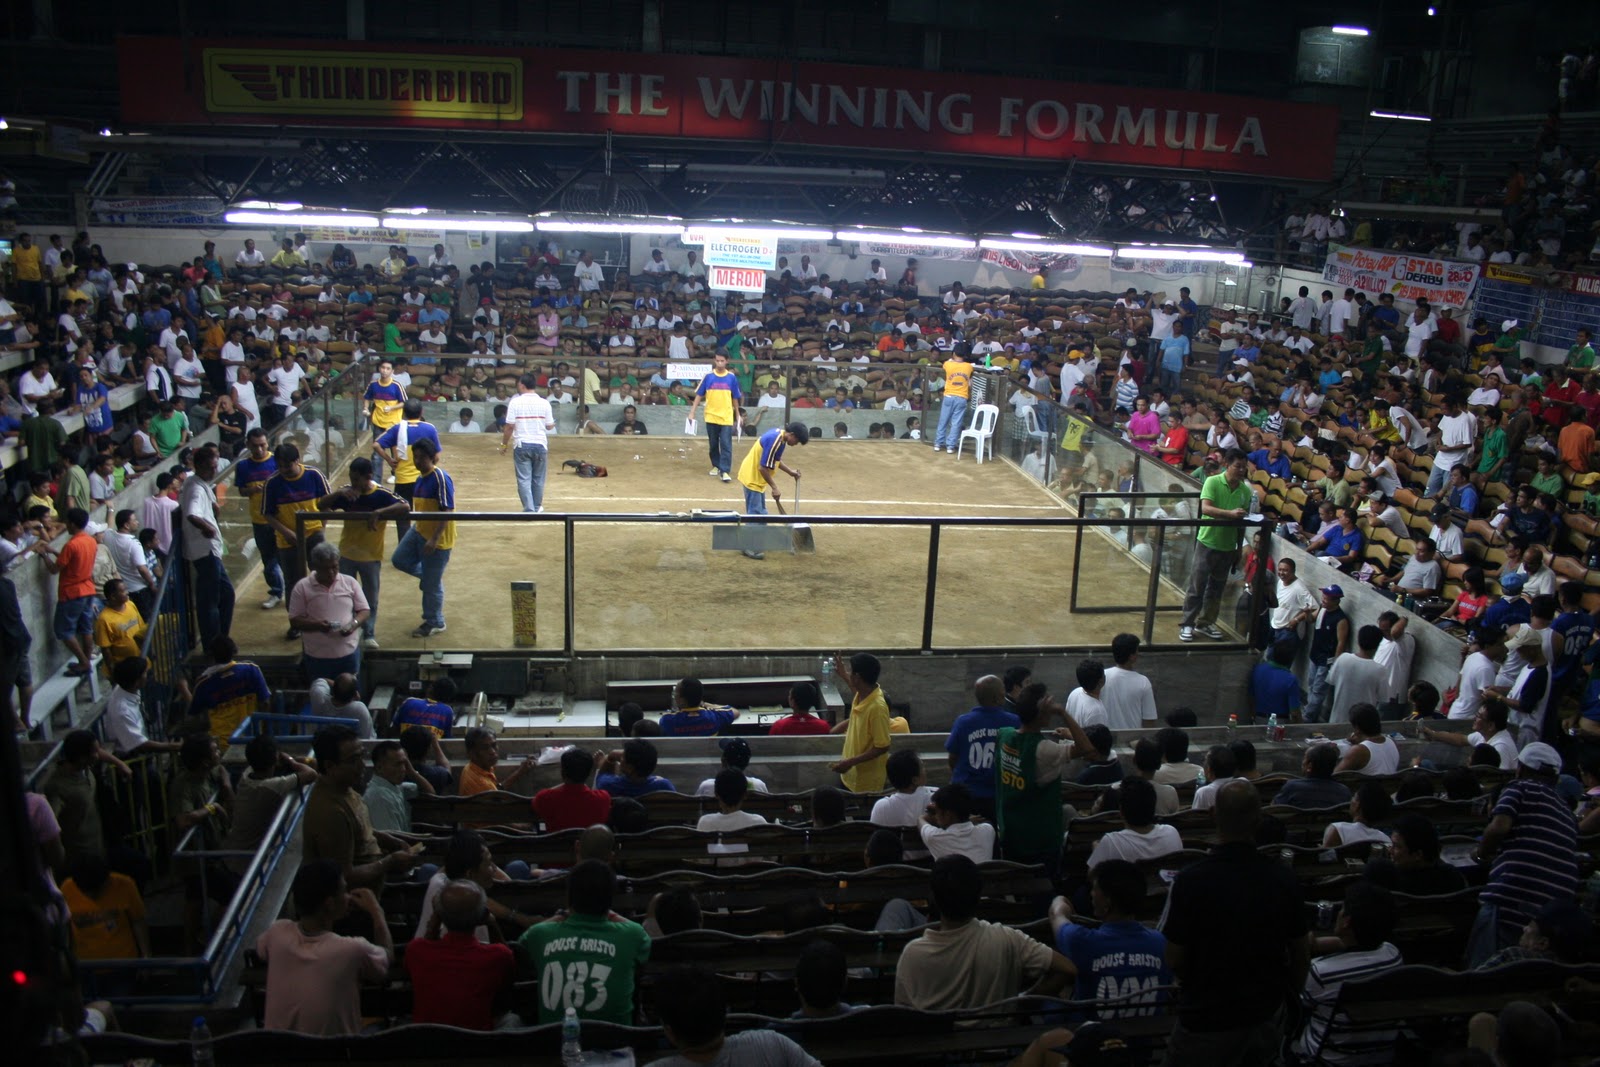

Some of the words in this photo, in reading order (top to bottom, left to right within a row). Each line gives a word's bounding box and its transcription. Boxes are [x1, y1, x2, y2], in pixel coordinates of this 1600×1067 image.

[275, 64, 511, 104] THUNDERBIRD
[555, 71, 669, 117] THE
[696, 76, 974, 135] WINNING
[995, 96, 1269, 157] FORMULA
[710, 243, 760, 254] ELECTROGEN
[762, 247, 774, 255] D+
[1407, 259, 1444, 276] STAG
[716, 269, 762, 288] MERON
[1405, 272, 1444, 286] DERBY
[1576, 277, 1600, 295] ROLIG
[968, 742, 996, 769] 06
[543, 936, 578, 957] HOUSE
[579, 937, 616, 958] KRISTO
[1091, 951, 1126, 972] HOUSE
[1128, 953, 1162, 970] KRISTO
[541, 960, 612, 1012] 083
